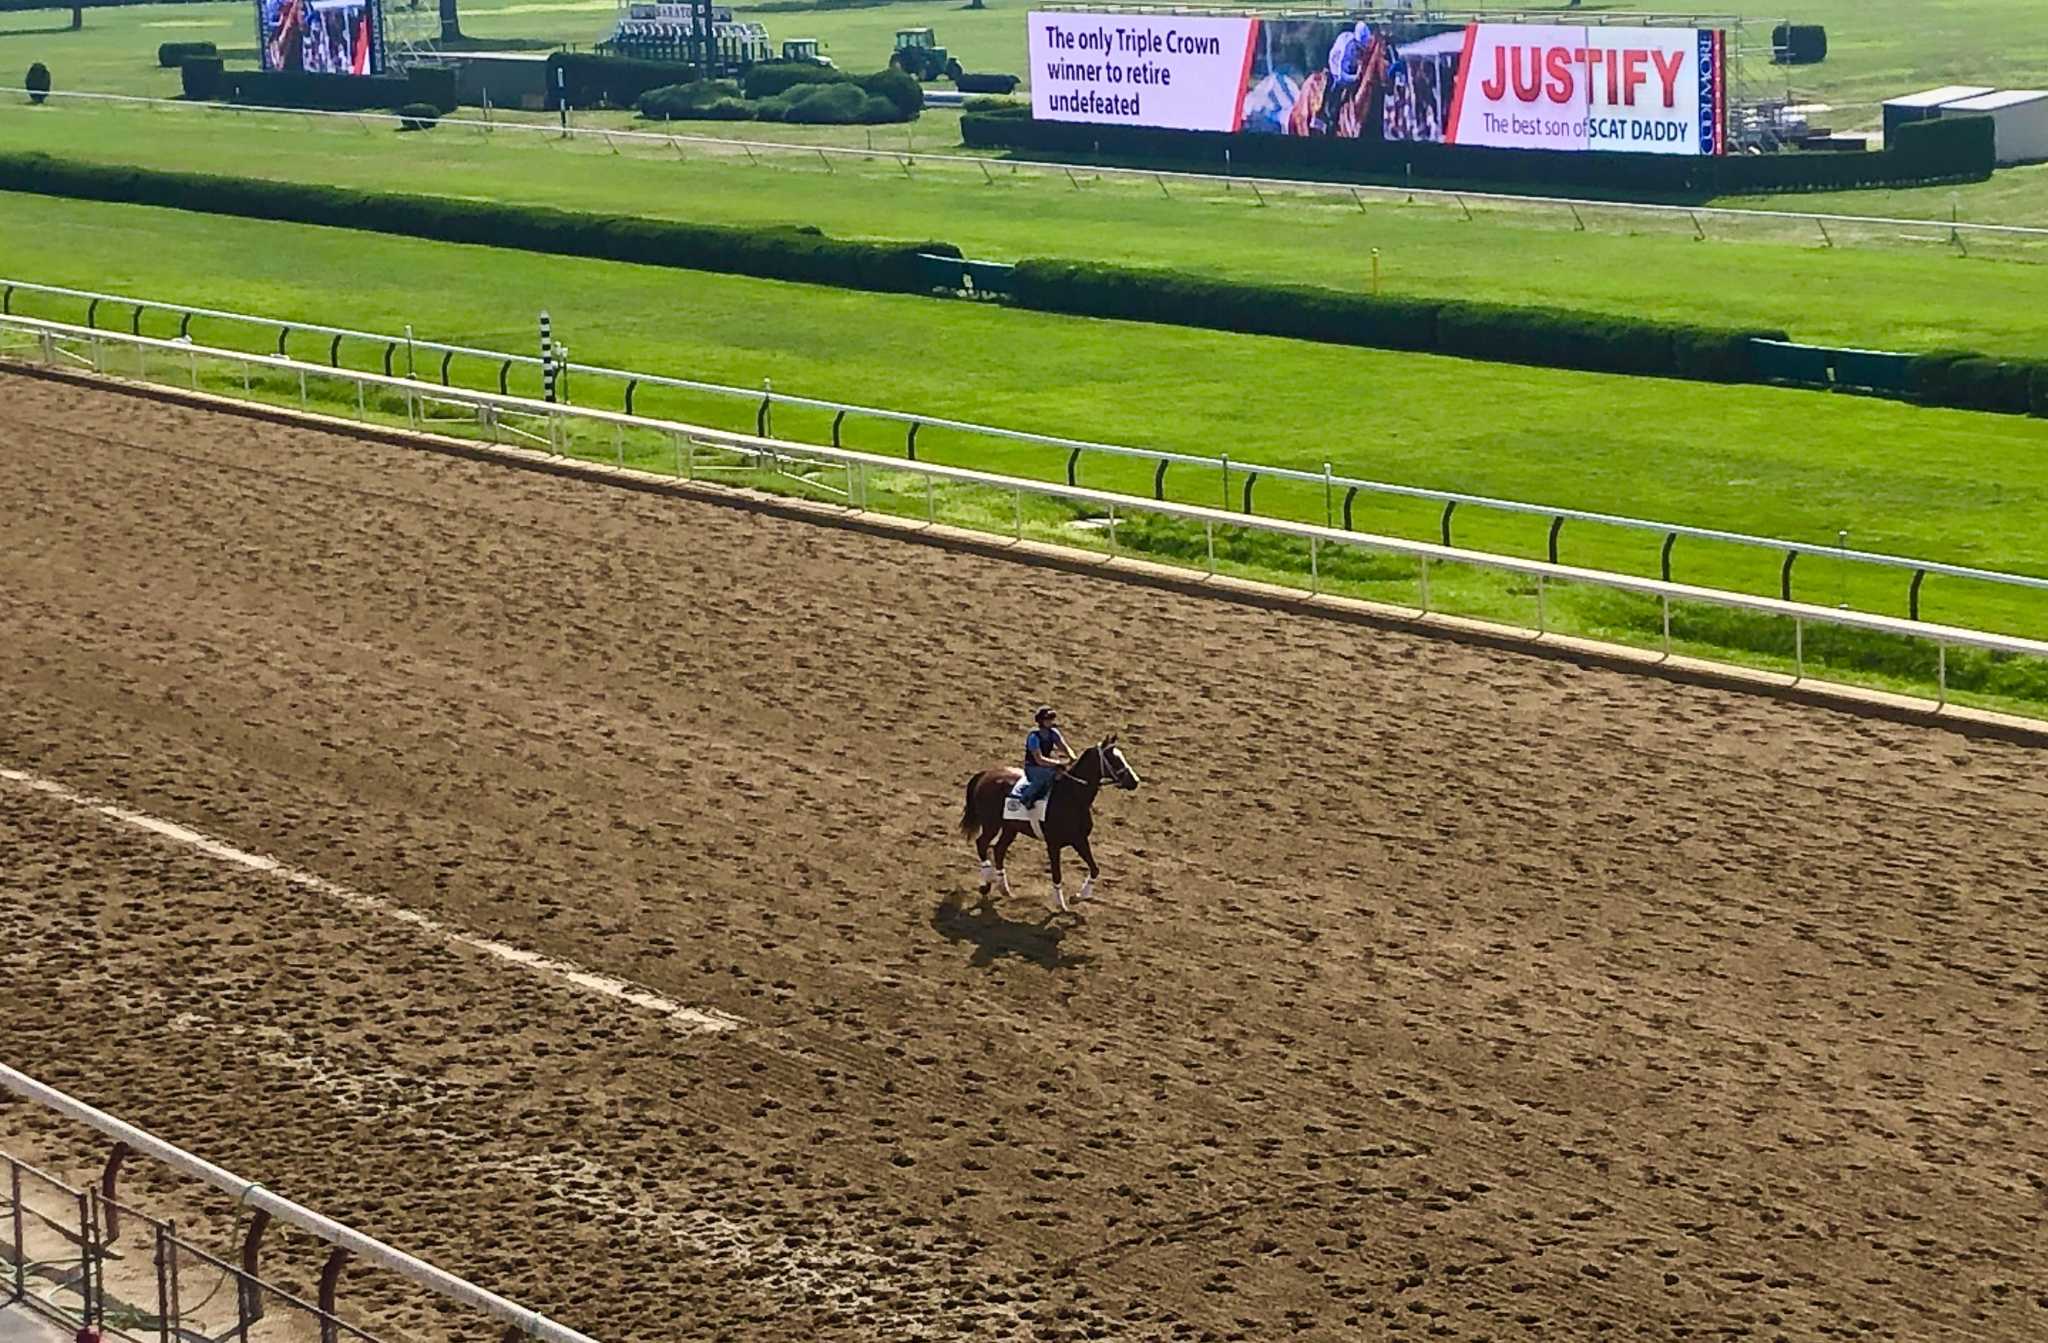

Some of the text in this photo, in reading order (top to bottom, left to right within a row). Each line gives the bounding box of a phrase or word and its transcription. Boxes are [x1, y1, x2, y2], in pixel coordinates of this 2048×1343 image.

[1046, 26, 1220, 58] The only Triple Crown
[1047, 57, 1171, 85] winner to retire
[1481, 46, 1685, 108] JUSTIFY
[1049, 89, 1140, 115] undefeated
[1483, 113, 1688, 142] The best son of SCAT DADDY
